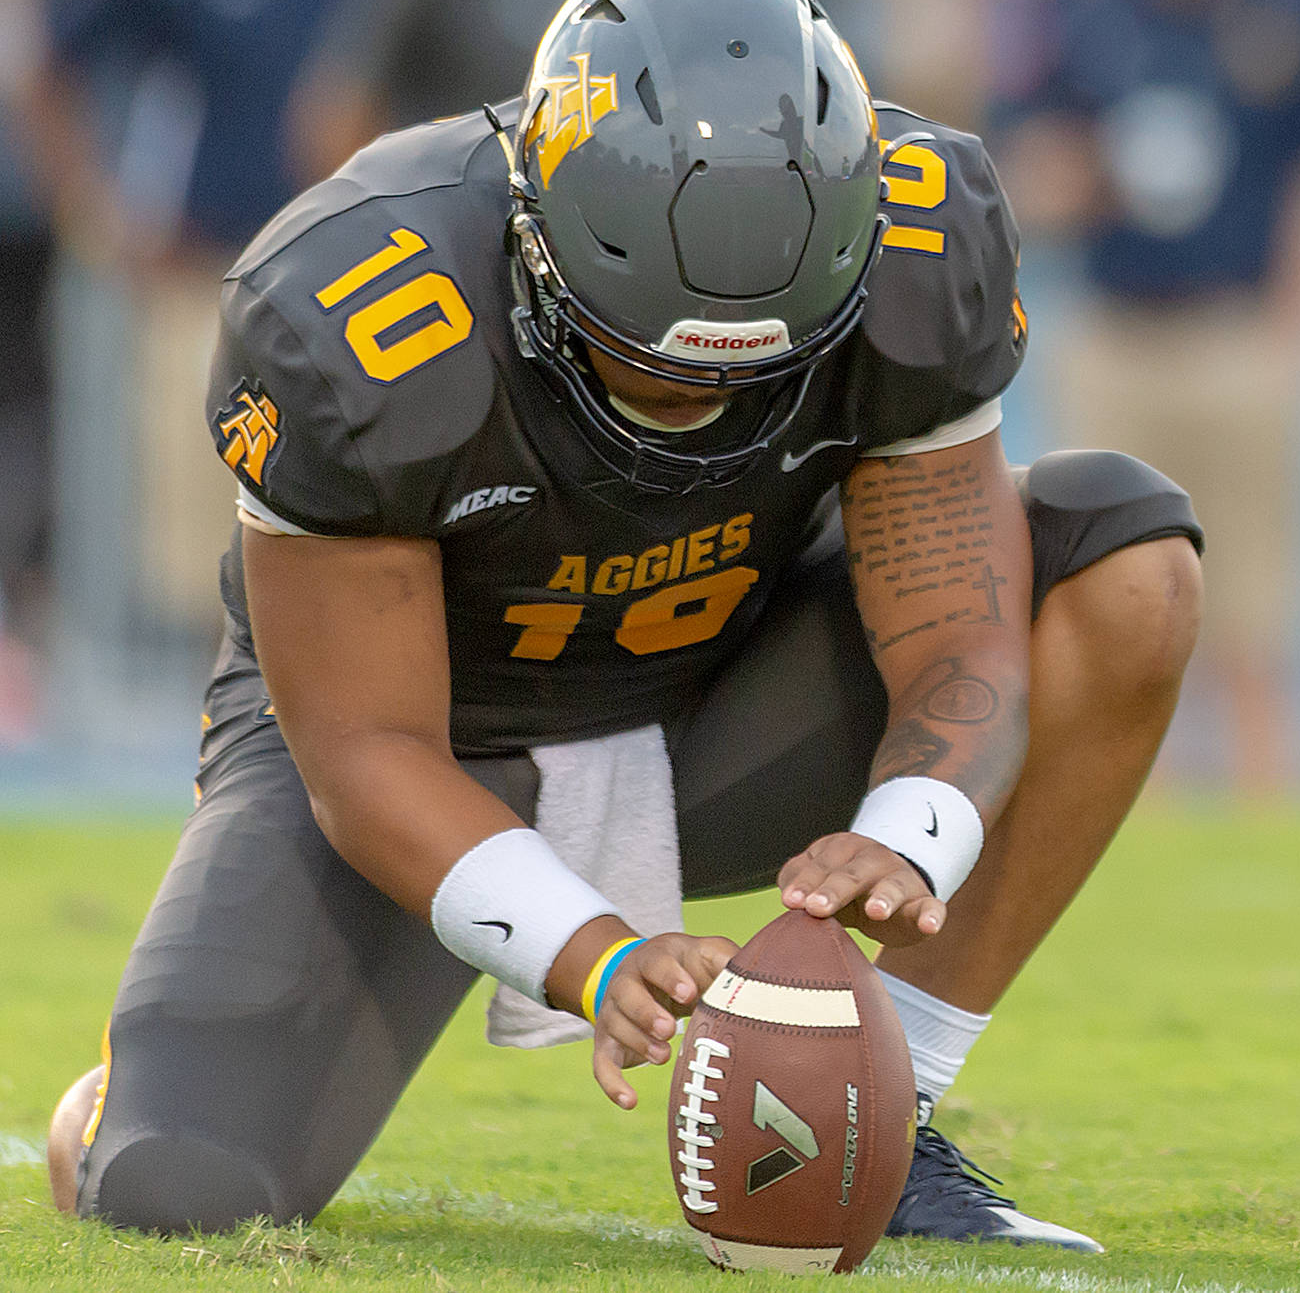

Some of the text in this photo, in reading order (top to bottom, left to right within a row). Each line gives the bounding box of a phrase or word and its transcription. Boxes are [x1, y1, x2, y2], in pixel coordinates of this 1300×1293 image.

[310, 226, 476, 386] 10
[442, 485, 538, 525] MEAC
[547, 512, 755, 597] AGGIES
